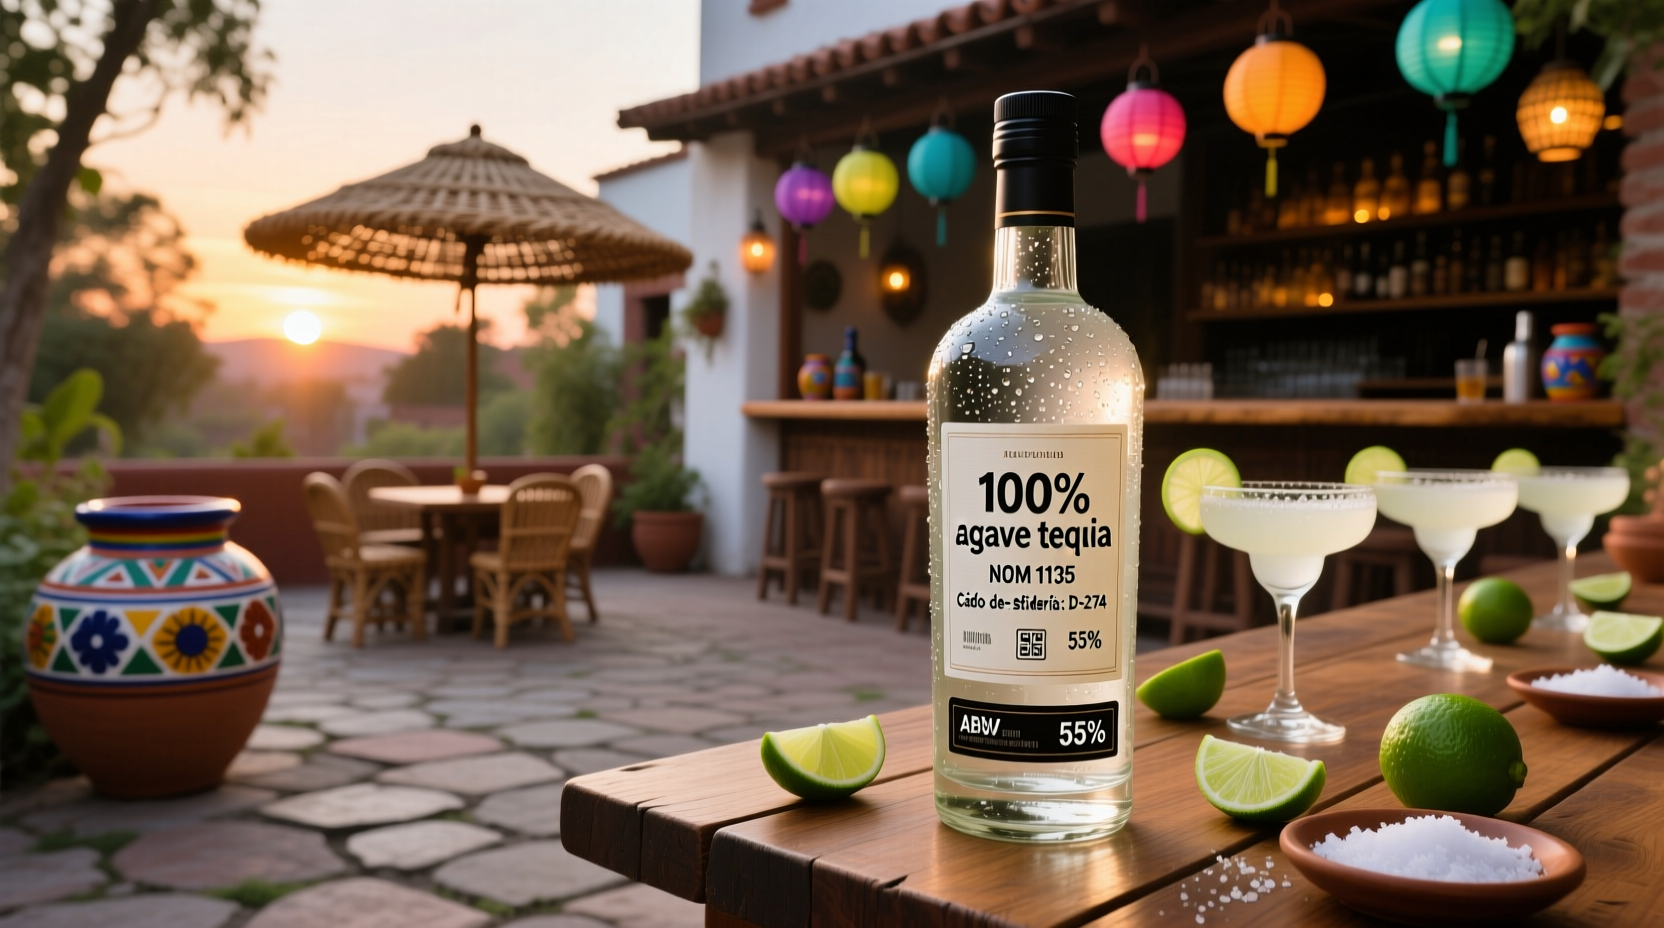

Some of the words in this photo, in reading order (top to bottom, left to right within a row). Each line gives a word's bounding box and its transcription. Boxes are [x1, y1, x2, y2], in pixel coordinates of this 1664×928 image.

[978, 471, 1090, 515] 100%
[955, 524, 1031, 555] agave
[989, 564, 1031, 584] NOM
[1035, 565, 1076, 585] 1135
[1068, 594, 1107, 611] D-274
[1068, 630, 1102, 650] 55%
[1059, 719, 1106, 747] 55%
